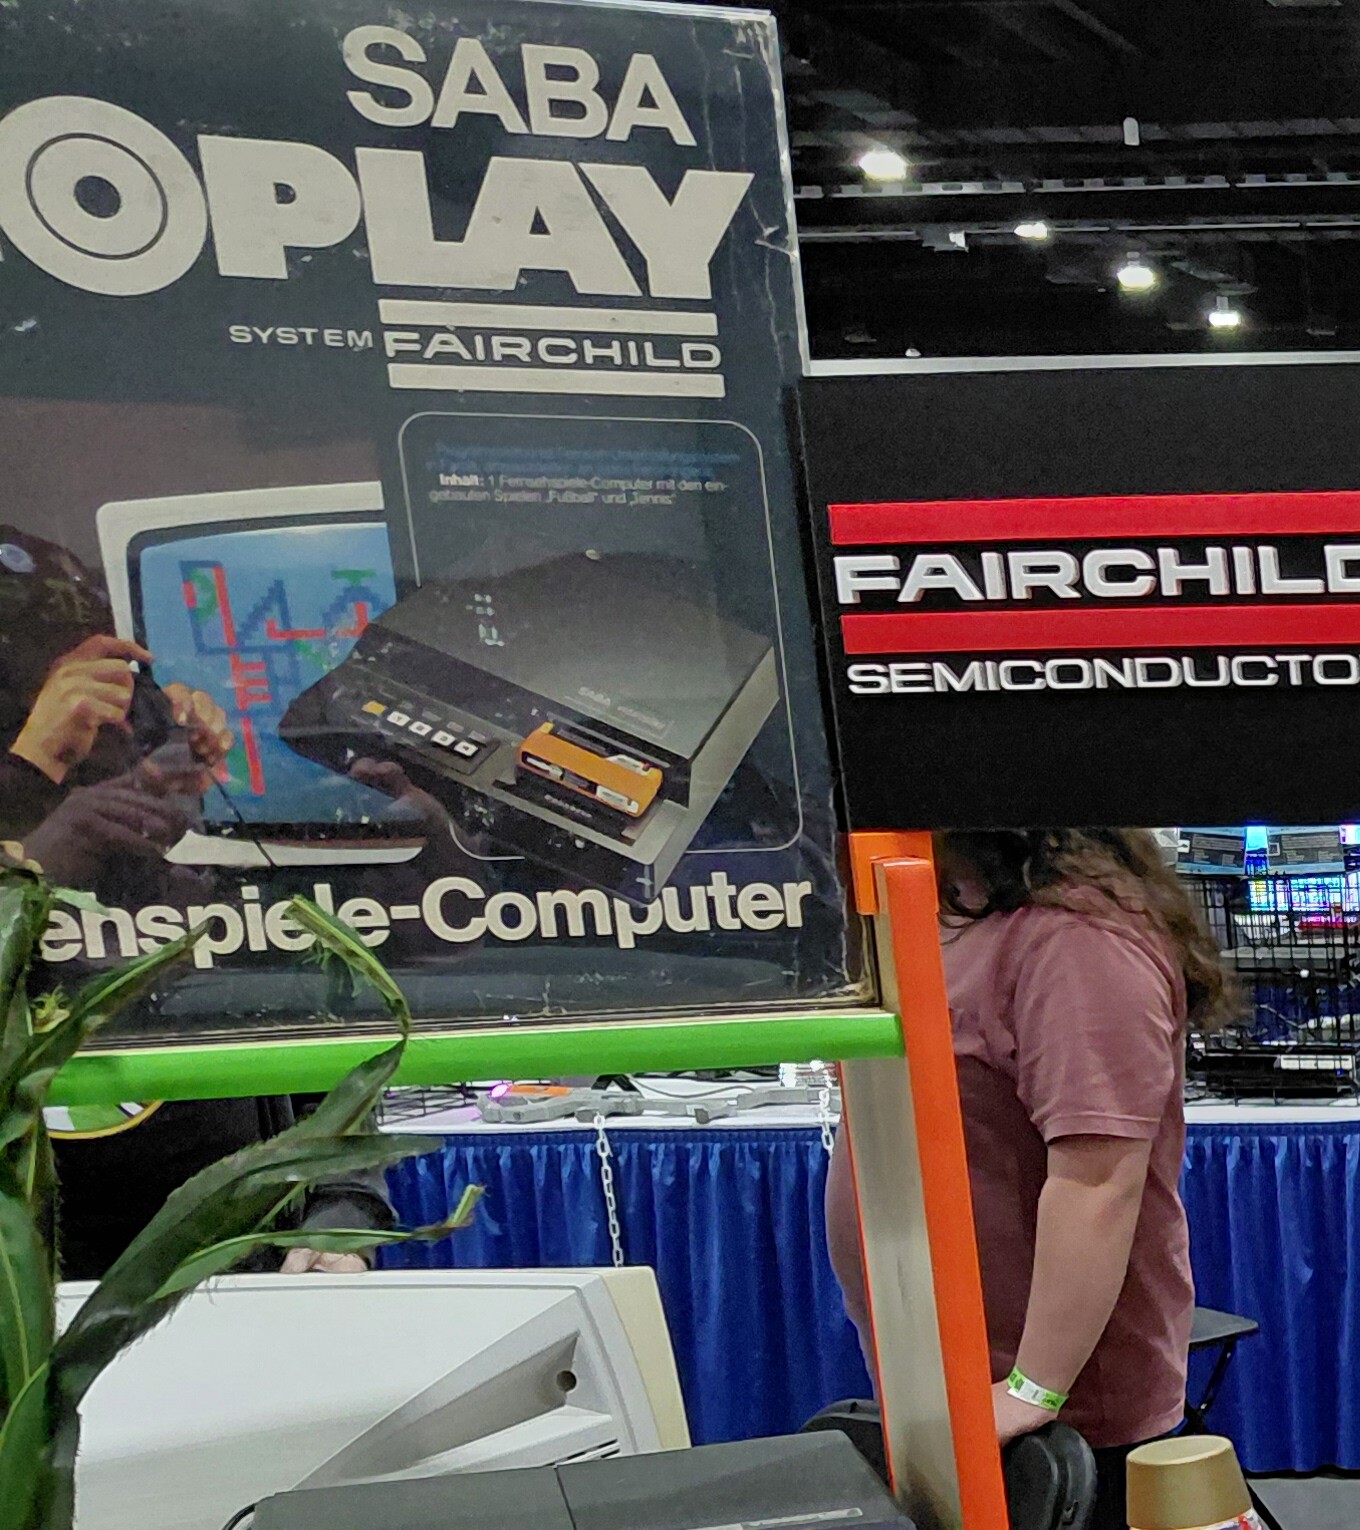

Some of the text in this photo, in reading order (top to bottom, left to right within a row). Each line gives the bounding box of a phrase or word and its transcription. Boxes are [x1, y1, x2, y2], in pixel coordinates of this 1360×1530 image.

[343, 26, 696, 146] SABA
[230, 326, 721, 368] SYSTEM FAIRCHILD
